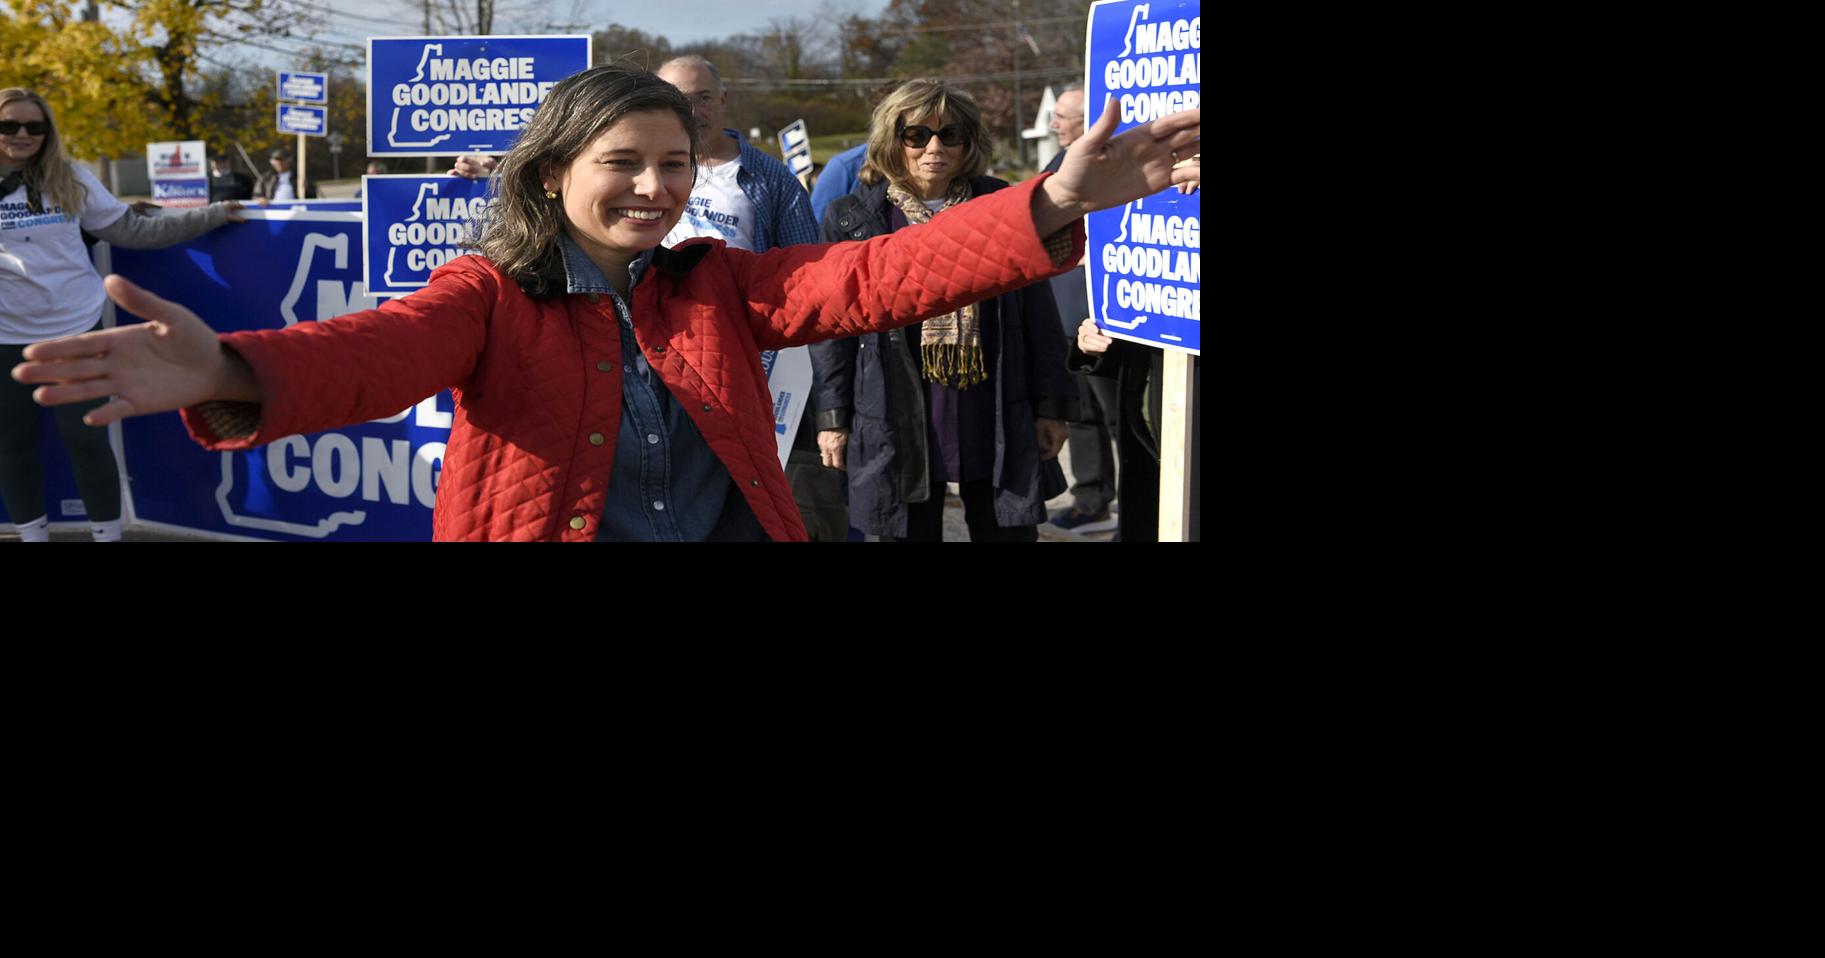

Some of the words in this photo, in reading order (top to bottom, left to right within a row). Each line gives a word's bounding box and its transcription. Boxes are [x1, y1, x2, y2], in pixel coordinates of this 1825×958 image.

[429, 57, 535, 81] MAGGIE
[1105, 53, 1200, 90] GOODLA
[392, 82, 560, 106] GOODLANDE
[1121, 90, 1200, 124] CONGR
[0, 202, 29, 212] MAG
[407, 248, 484, 272] CON
[267, 433, 447, 508] CONG
